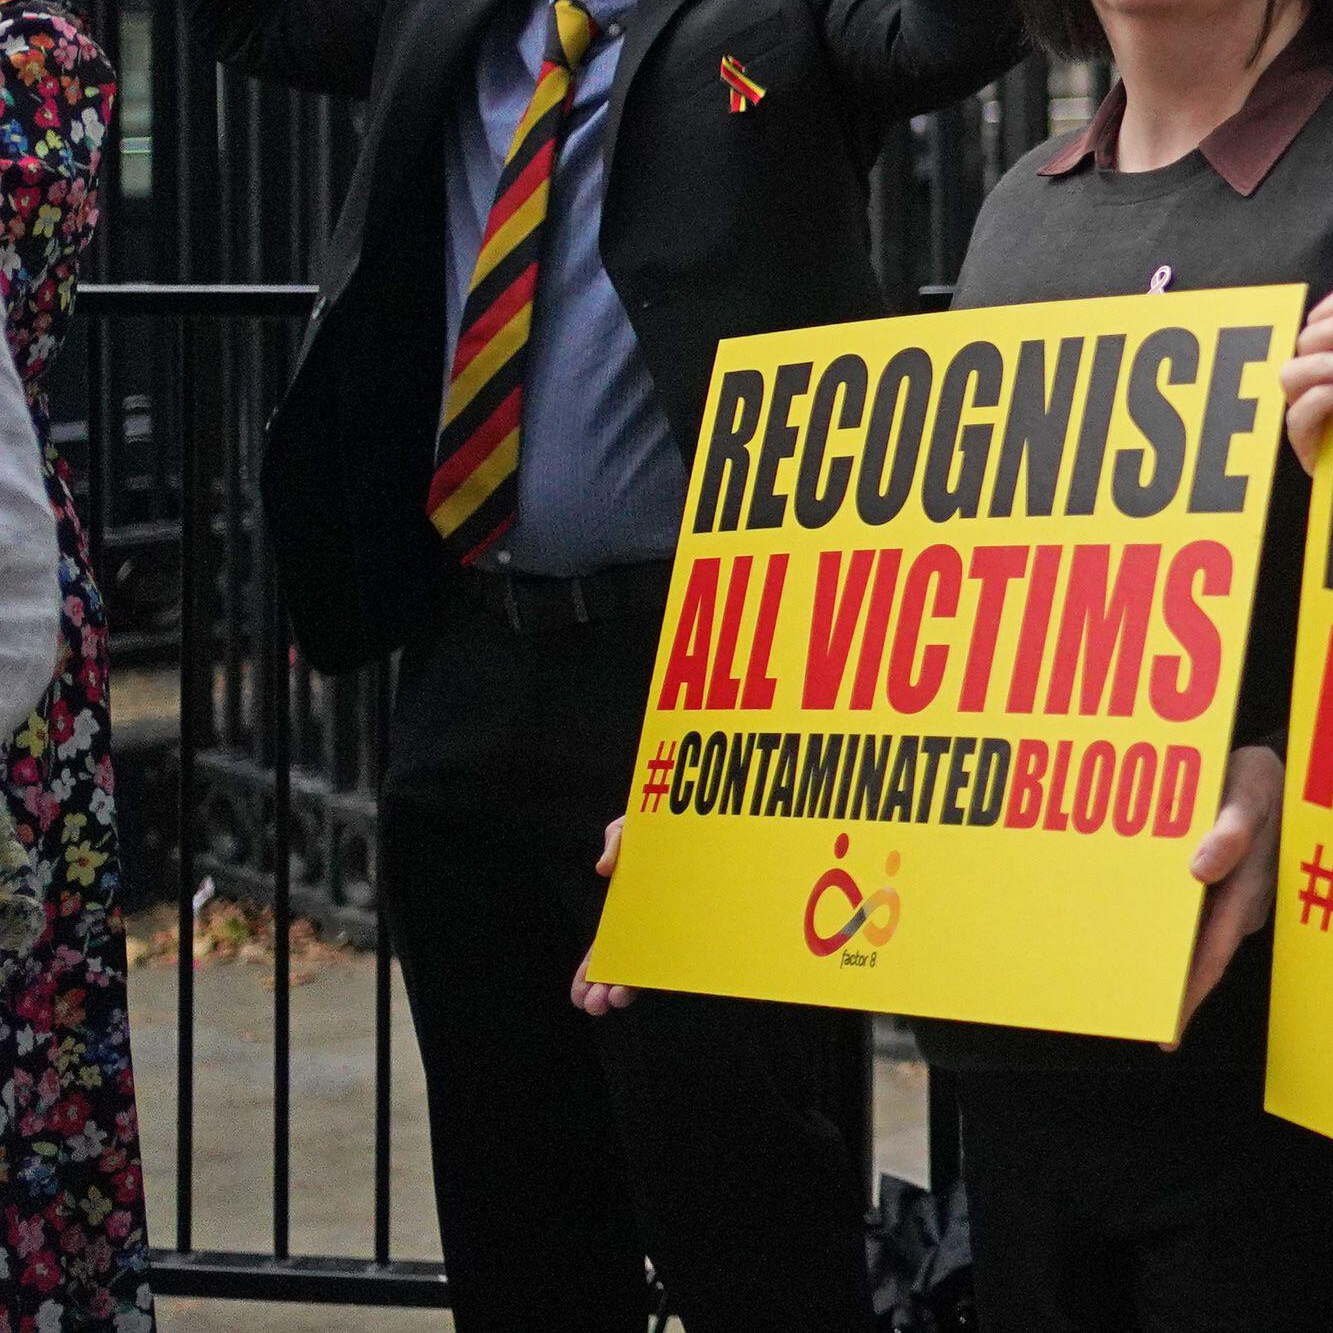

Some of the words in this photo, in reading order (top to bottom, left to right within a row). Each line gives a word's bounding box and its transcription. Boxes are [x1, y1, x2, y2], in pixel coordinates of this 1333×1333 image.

[692, 325, 1274, 534] RECOGNISE
[657, 553, 790, 711] ALL
[802, 539, 1234, 723] VICTIMS
[641, 731, 1203, 839] #CONTAMINATEDBLOOD
[840, 949, 868, 969] factor
[869, 952, 877, 967] 8
